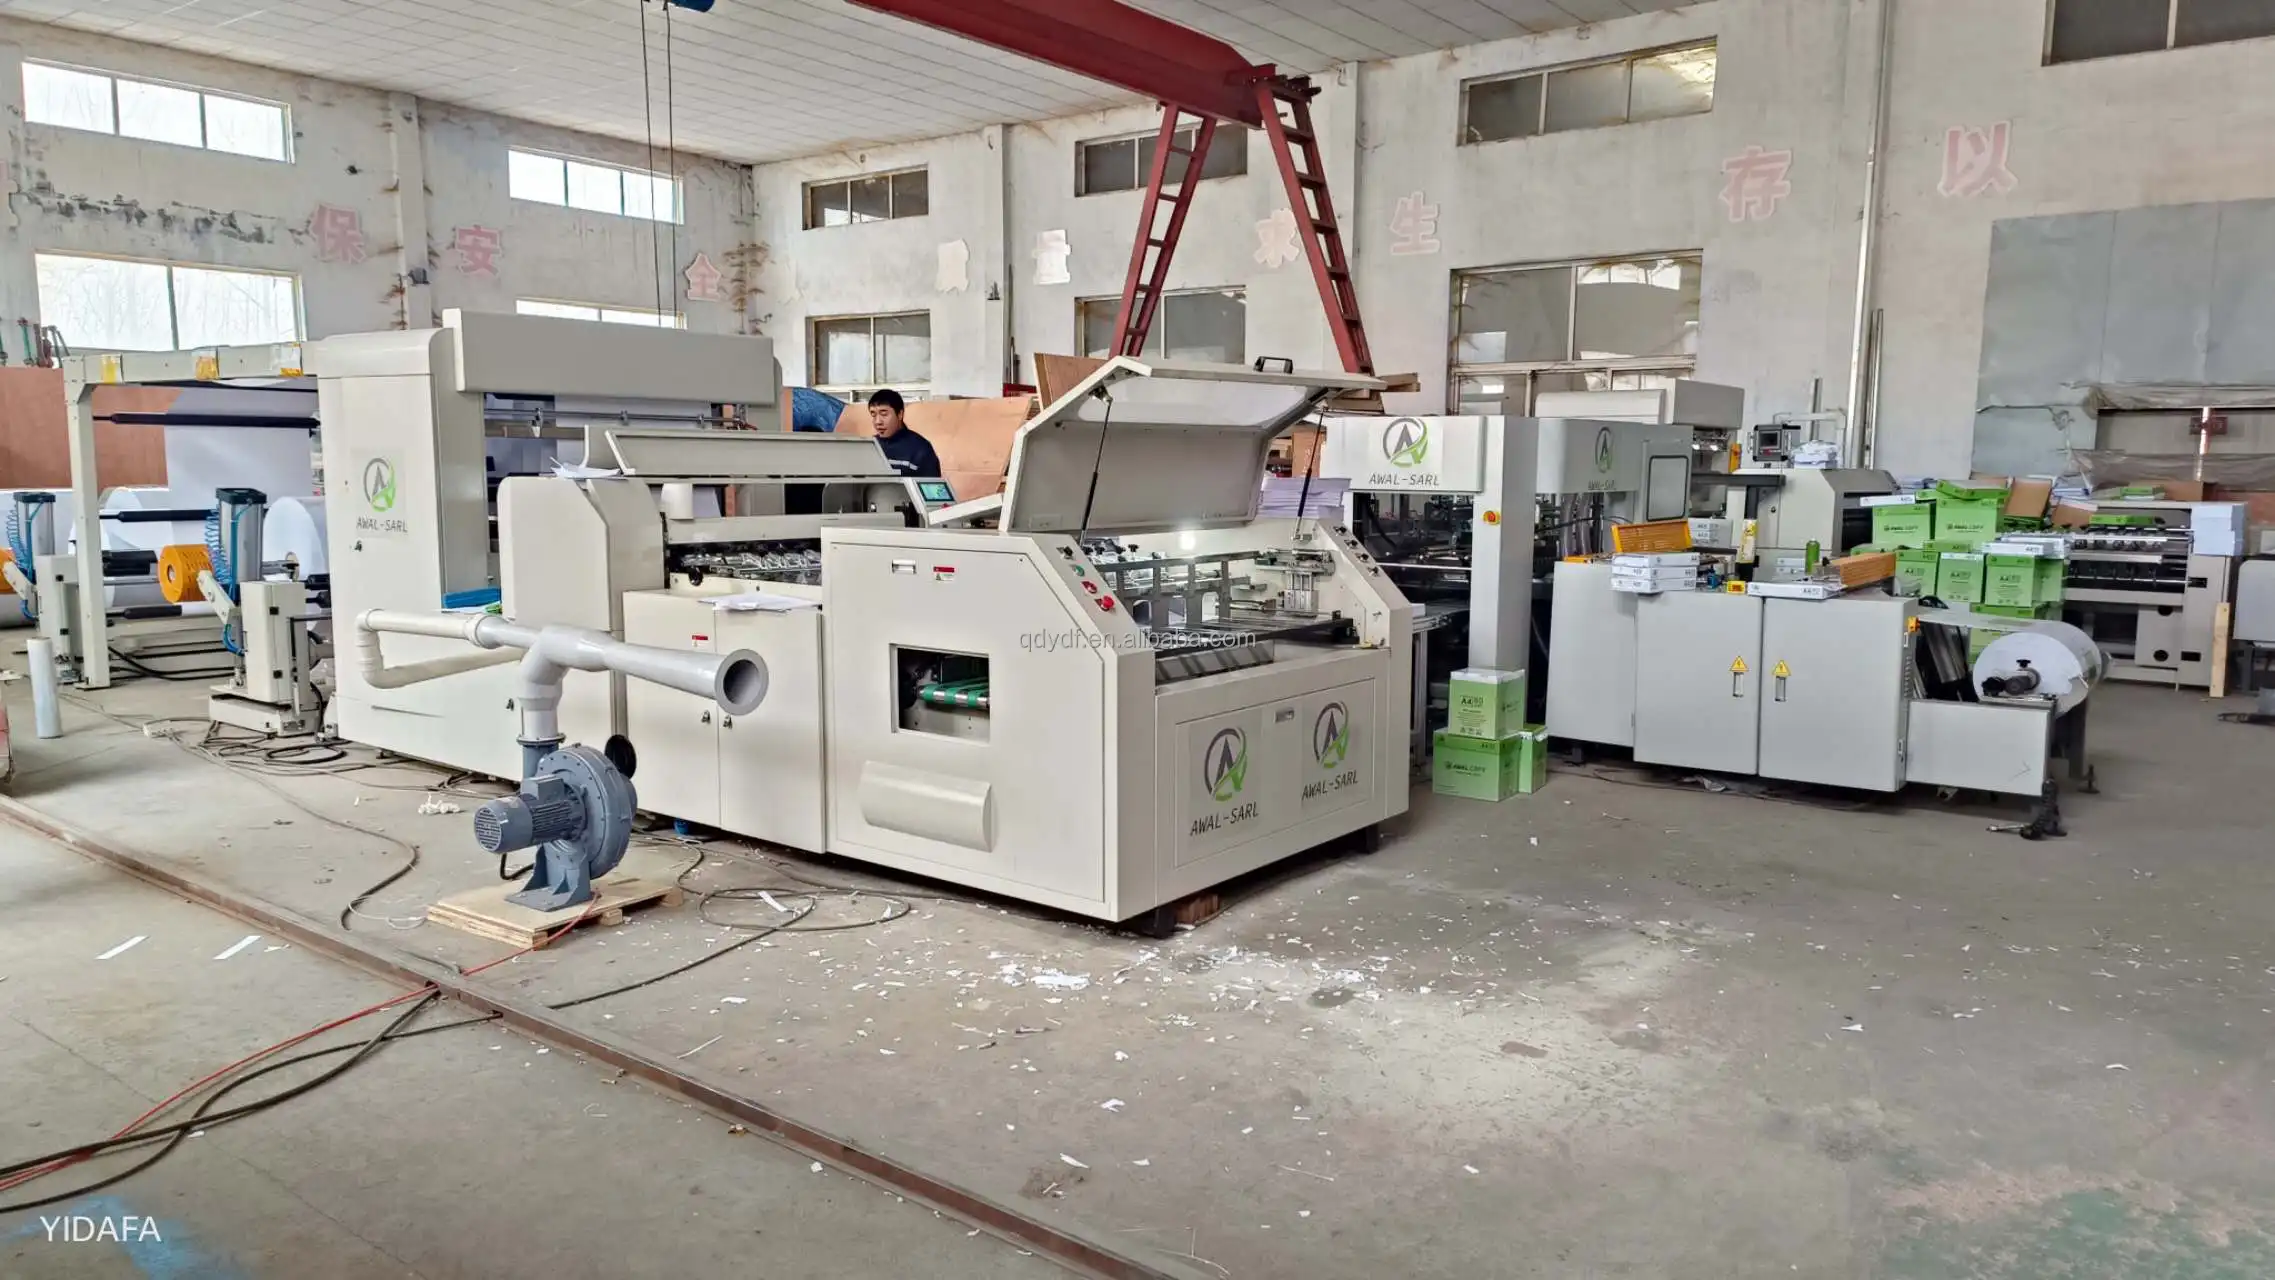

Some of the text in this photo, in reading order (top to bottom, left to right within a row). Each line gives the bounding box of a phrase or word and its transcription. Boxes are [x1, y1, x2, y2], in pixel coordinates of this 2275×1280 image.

[1938, 120, 2018, 197] 以
[1390, 191, 1440, 255] 生
[1719, 145, 1792, 223] 存
[309, 203, 366, 264] 保
[456, 225, 501, 278] 安
[1368, 472, 1440, 487] AWAL-SARL
[355, 516, 408, 534] AWAL-SARL
[1301, 769, 1359, 801] AWAL-SARL
[1190, 801, 1260, 837] AWAL-SARL
